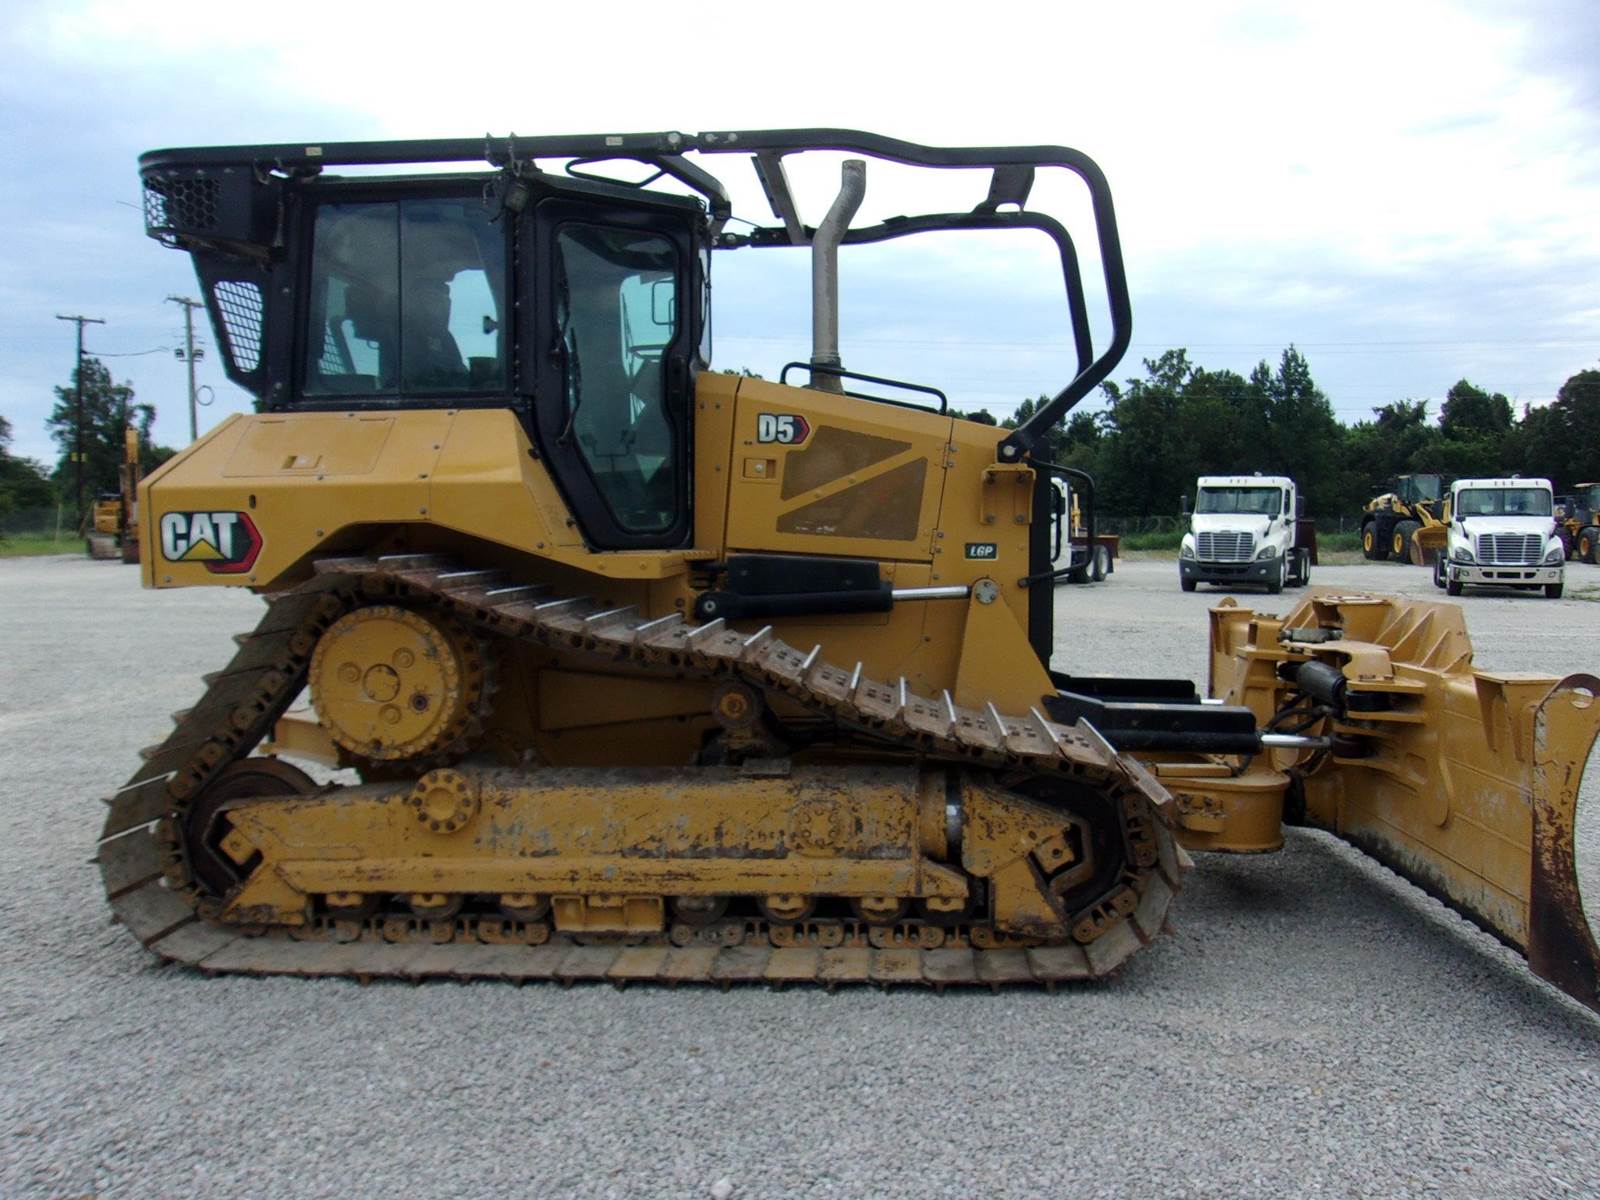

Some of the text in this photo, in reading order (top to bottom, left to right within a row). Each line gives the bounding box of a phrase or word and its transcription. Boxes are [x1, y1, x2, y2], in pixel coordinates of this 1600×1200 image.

[758, 414, 794, 443] D5
[161, 512, 238, 560] CAT
[969, 545, 994, 557] LGP
